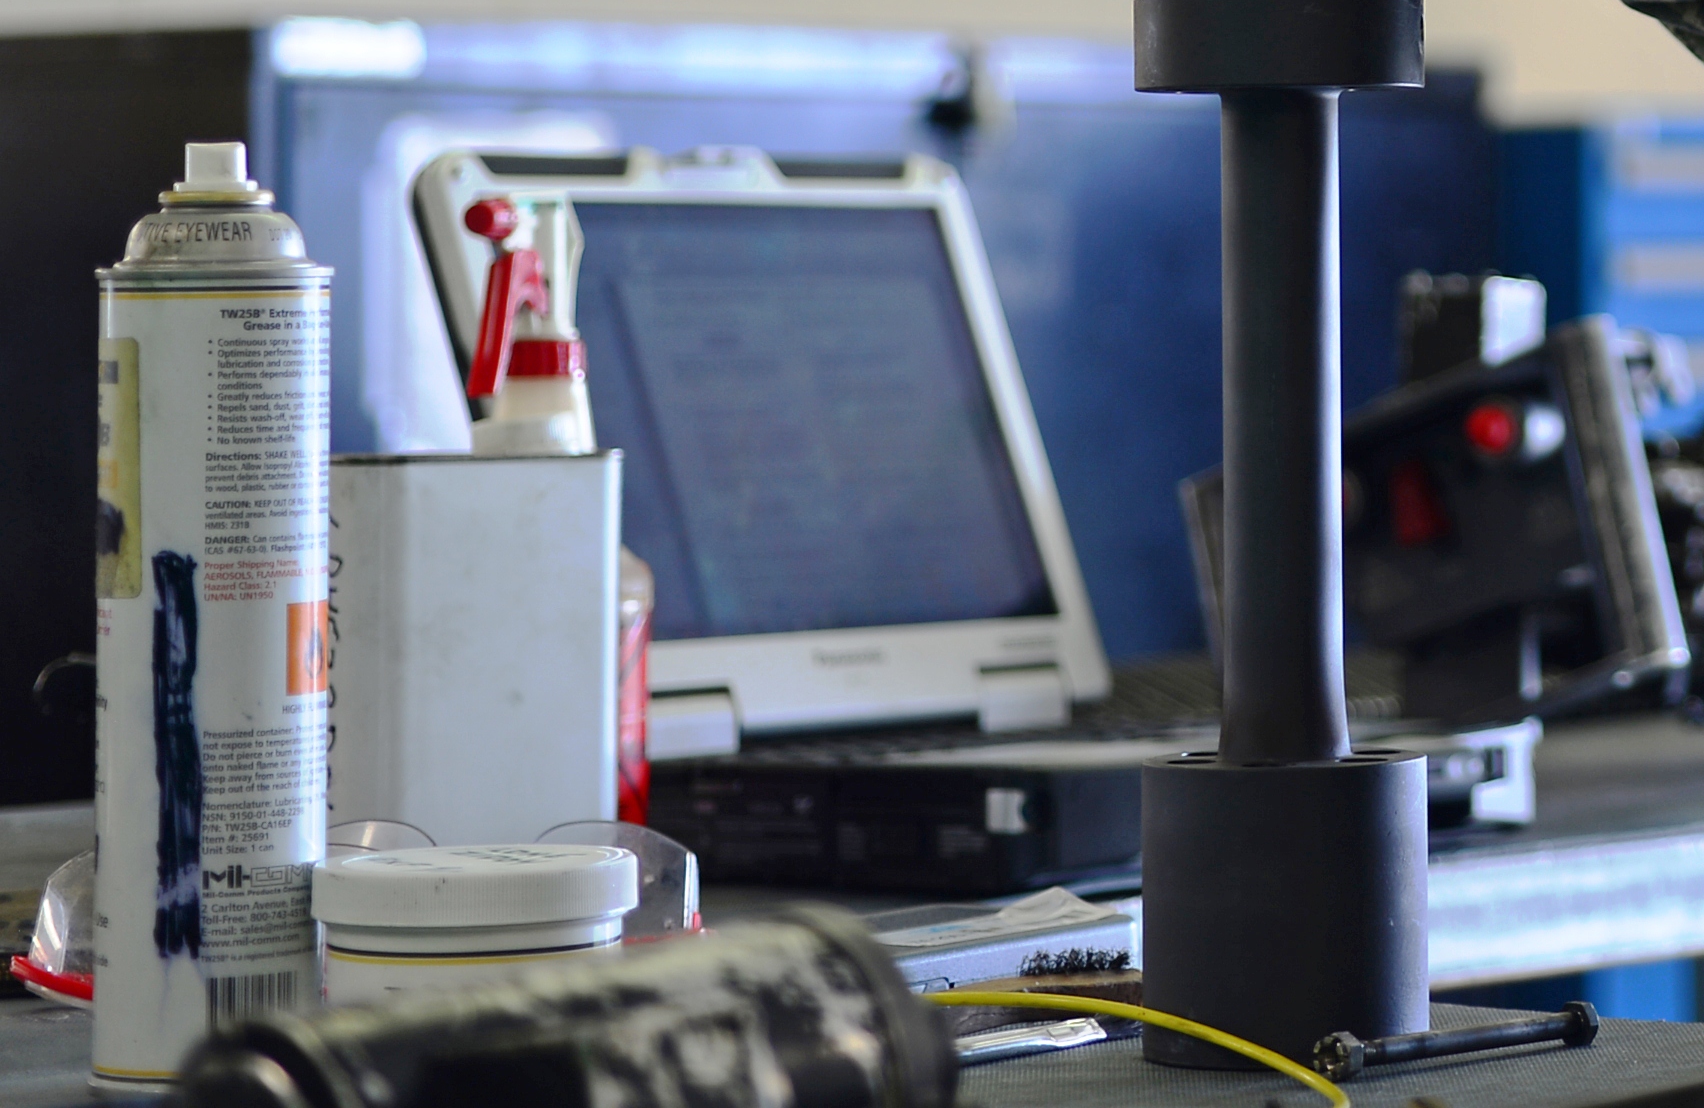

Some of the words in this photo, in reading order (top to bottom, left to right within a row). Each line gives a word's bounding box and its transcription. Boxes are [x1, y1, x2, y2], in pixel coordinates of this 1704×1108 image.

[175, 221, 253, 242] EYEWEAR
[243, 320, 280, 330] Grease
[284, 320, 292, 330] in
[217, 338, 266, 347] Continuous
[270, 338, 289, 346] spray
[217, 348, 261, 358] Optimizes
[218, 359, 263, 368] lubrication
[218, 371, 257, 380] Performs
[260, 371, 302, 379] dependably
[217, 382, 262, 390] conditions
[217, 392, 249, 402] Greatly
[252, 391, 282, 399] reduces
[218, 403, 246, 412] Repels
[249, 402, 270, 412] sand,
[217, 414, 247, 423] Resists
[250, 413, 286, 422] wash-off,
[217, 436, 229, 444] No
[233, 436, 262, 444] known
[264, 435, 296, 443] shelf-life
[206, 452, 261, 461] Directions:
[264, 451, 287, 459] SHAKE
[206, 463, 238, 472] surfaces.
[241, 463, 261, 471] Allow
[206, 474, 234, 483] prevent
[237, 473, 258, 481] debris
[216, 484, 239, 493] wood,
[205, 500, 251, 510] CAUTION:
[254, 499, 271, 508] KEEP
[273, 499, 286, 507] OUT
[205, 511, 243, 520] ventilated
[269, 509, 287, 517] Avoid
[205, 522, 228, 530] HMIS:
[205, 536, 250, 545] DANGER:
[253, 535, 266, 543] Can
[269, 534, 296, 542] contains
[204, 562, 234, 570] Proper
[237, 560, 274, 570] Shipping
[204, 572, 254, 580] AEROSOLS,
[204, 583, 235, 591] Hazard
[239, 582, 262, 590] Class:
[204, 593, 236, 601] UN/NA:
[240, 592, 274, 600] UN1950
[203, 729, 253, 739] Pressurized
[203, 742, 218, 750] not
[221, 742, 252, 751] expose
[255, 740, 263, 748] to
[218, 752, 234, 760] not
[236, 751, 262, 762] pierce
[226, 762, 253, 771] naked
[256, 761, 278, 770] flame
[202, 775, 225, 784] Keep
[228, 774, 252, 783] away
[255, 772, 274, 780] from
[202, 785, 225, 794] Keep
[246, 783, 254, 792] of
[256, 783, 270, 791] the
[272, 781, 292, 790] reach
[202, 802, 272, 811] Nomenclature:
[202, 813, 226, 822] NSN:
[202, 824, 221, 832] P/N:
[242, 833, 269, 842] 25691
[202, 846, 223, 855] Unit
[226, 846, 247, 854] Size:
[212, 903, 249, 912] Carlton
[252, 901, 288, 910] Avenue,
[202, 915, 246, 925] Toll-Free:
[202, 926, 237, 936] E-mail:
[201, 933, 300, 948] www.mil-comm.com
